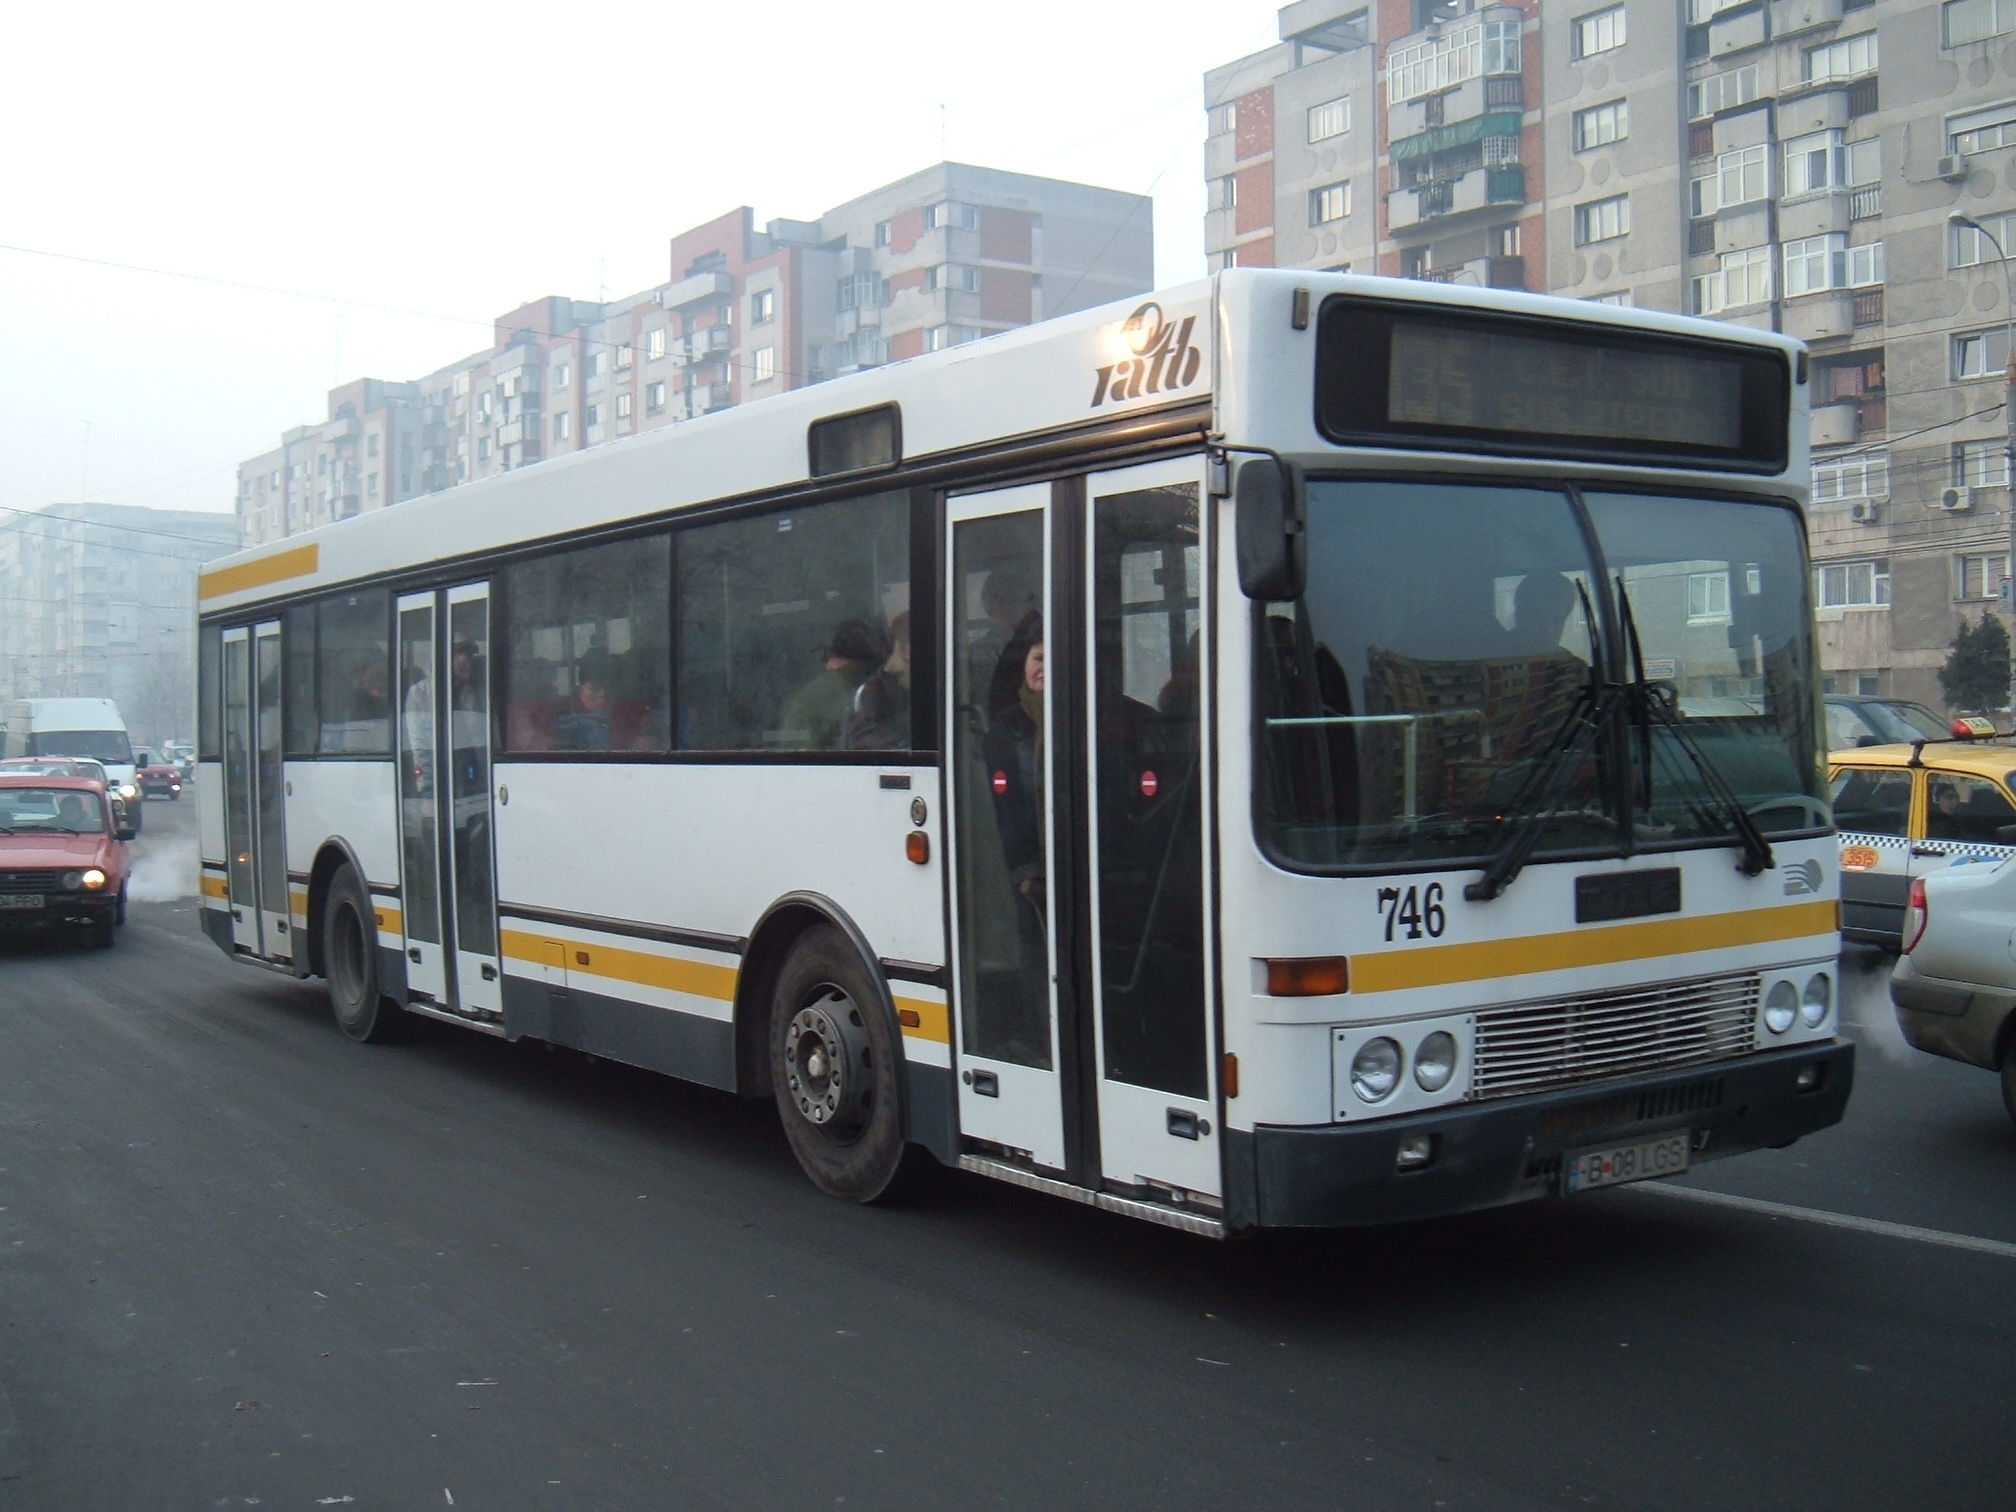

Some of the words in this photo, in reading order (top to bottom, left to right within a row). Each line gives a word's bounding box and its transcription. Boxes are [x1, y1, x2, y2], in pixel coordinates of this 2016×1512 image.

[1377, 881, 1445, 942] 746
[1588, 1155, 1603, 1183] B
[1641, 1139, 1683, 1173] LGS
